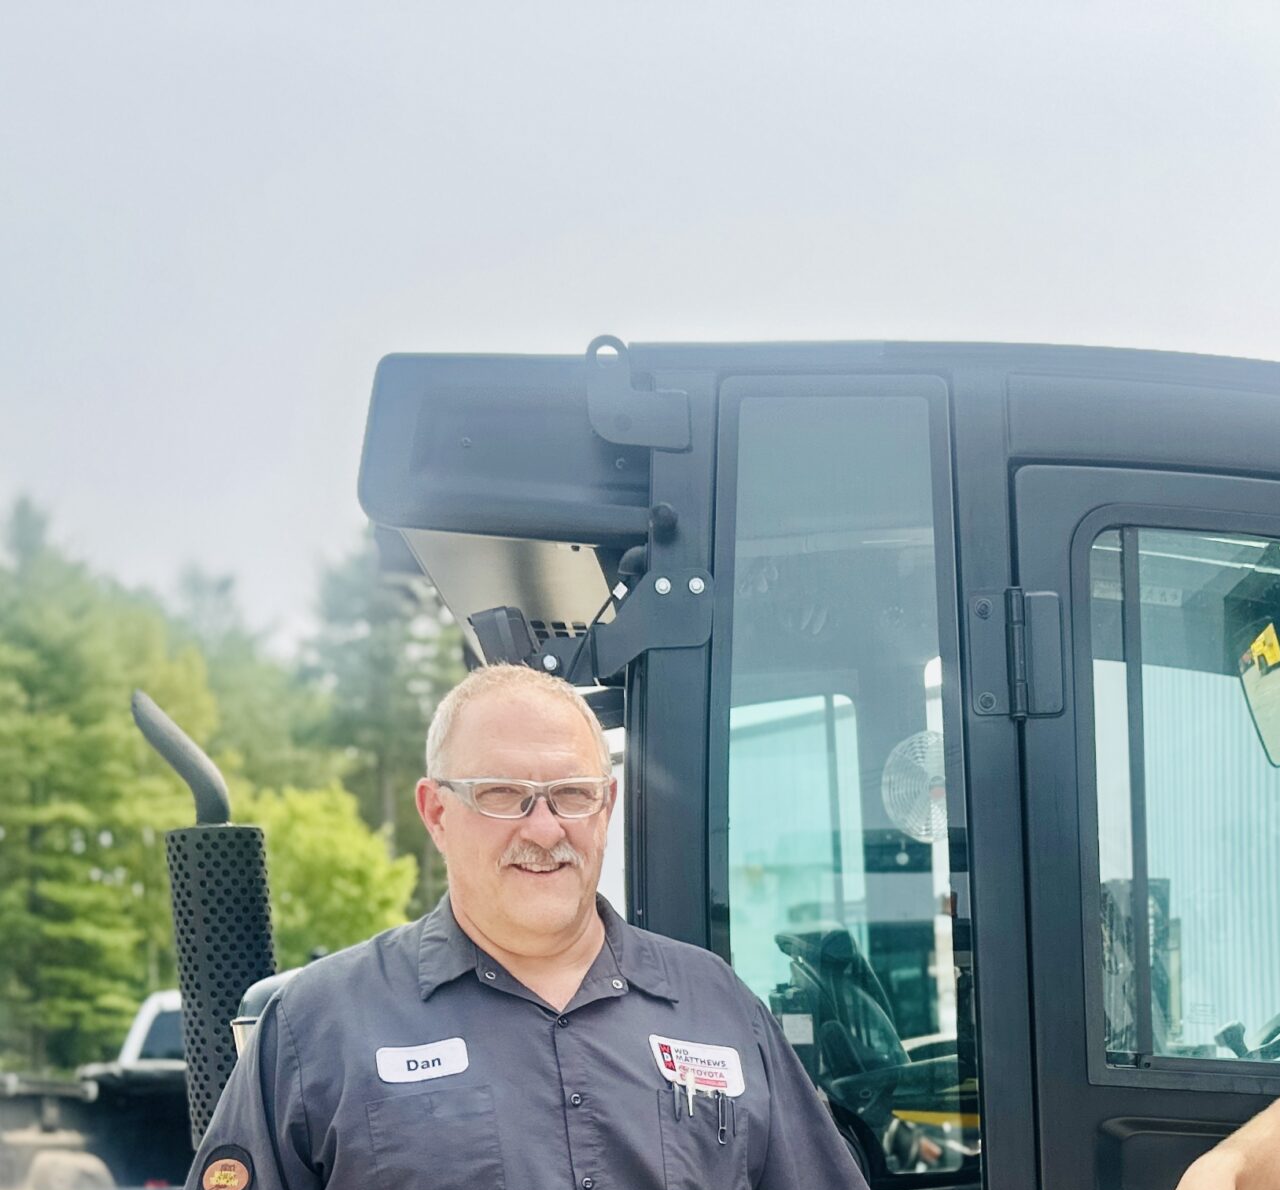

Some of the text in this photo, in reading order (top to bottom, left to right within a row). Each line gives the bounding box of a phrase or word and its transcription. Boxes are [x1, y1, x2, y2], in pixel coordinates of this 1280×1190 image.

[674, 1047, 689, 1055] WD
[406, 1057, 441, 1071] Dan
[676, 1055, 727, 1068] MATTHEWS
[690, 1066, 725, 1079] TOYOTA
